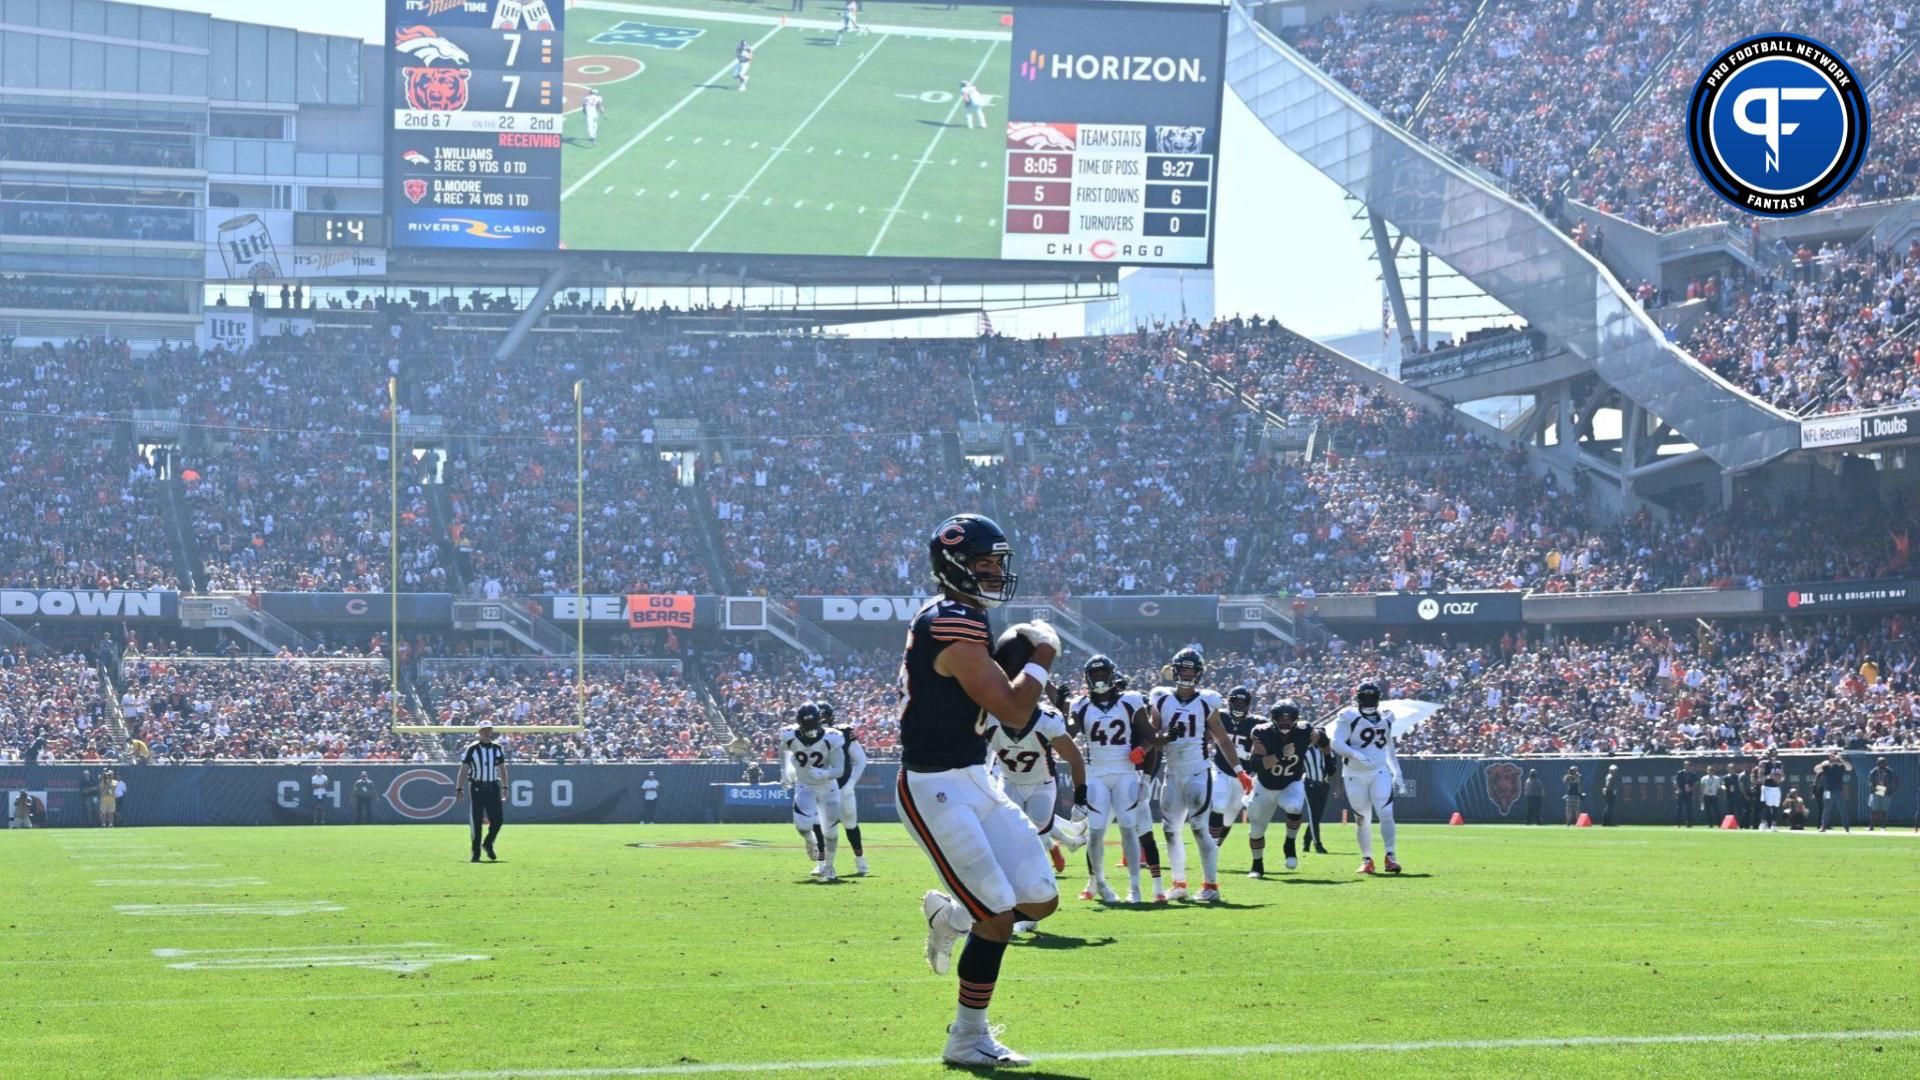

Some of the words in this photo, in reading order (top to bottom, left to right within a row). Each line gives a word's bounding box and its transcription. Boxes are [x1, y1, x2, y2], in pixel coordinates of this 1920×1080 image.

[405, 0, 424, 11] IT'S
[463, 2, 487, 13] TIME
[503, 33, 521, 66] 7
[502, 75, 521, 108] 7
[404, 113, 428, 127] 2nd
[432, 114, 440, 128] &
[444, 114, 452, 128] 7
[498, 116, 515, 129] 22
[530, 117, 553, 130] 2nd
[499, 133, 561, 148] RECEIVING
[1081, 129, 1108, 146] TEAM
[1110, 130, 1142, 147] STATS
[435, 147, 493, 161] J.WILLIAMS
[434, 160, 441, 172] 3
[444, 160, 464, 172] REC
[469, 160, 476, 172] 9
[479, 161, 499, 173] YDS
[504, 162, 511, 173] 0
[513, 162, 527, 174] TD
[1024, 157, 1057, 173] 8:05
[1078, 159, 1101, 174] TIME
[1102, 159, 1114, 175] OF
[1115, 160, 1141, 176] POSS.
[1162, 161, 1194, 177] 9:27
[434, 179, 482, 193] D.MOORE
[1034, 185, 1044, 202] 5
[434, 192, 441, 204] 4
[444, 192, 464, 205] REC
[469, 193, 481, 205] 74
[483, 193, 503, 206] YDS
[515, 194, 529, 206] TD
[1077, 187, 1102, 203] FIRST
[1104, 188, 1140, 204] DOWNS
[1171, 188, 1182, 205] 6
[408, 223, 460, 232] RIVERS
[494, 225, 546, 234] CASINO
[1033, 214, 1043, 230] 0
[1080, 215, 1134, 231] TURNOVERS
[1170, 217, 1180, 233] 0
[229, 231, 269, 264] Lite
[352, 256, 376, 266] TIME
[210, 318, 247, 341] Lite
[1803, 429, 1818, 442] NFL
[1820, 426, 1860, 441] Receiving
[1874, 416, 1907, 436] Doubs
[650, 597, 673, 607] GO
[1819, 593, 1834, 601] SEE
[1845, 591, 1886, 600] BRIGHTER
[1889, 589, 1906, 598] WAY
[0, 591, 161, 616] DOWN
[213, 606, 229, 616] 122
[823, 598, 930, 620] DOW
[1443, 602, 1478, 615] razr
[633, 611, 691, 623] BEARS
[1090, 719, 1127, 746] 42
[1168, 712, 1196, 738] 41
[1360, 727, 1387, 749] 93
[795, 751, 825, 768] 92
[997, 748, 1040, 773] 49
[740, 788, 762, 799] CBS
[768, 789, 791, 800] NFL
